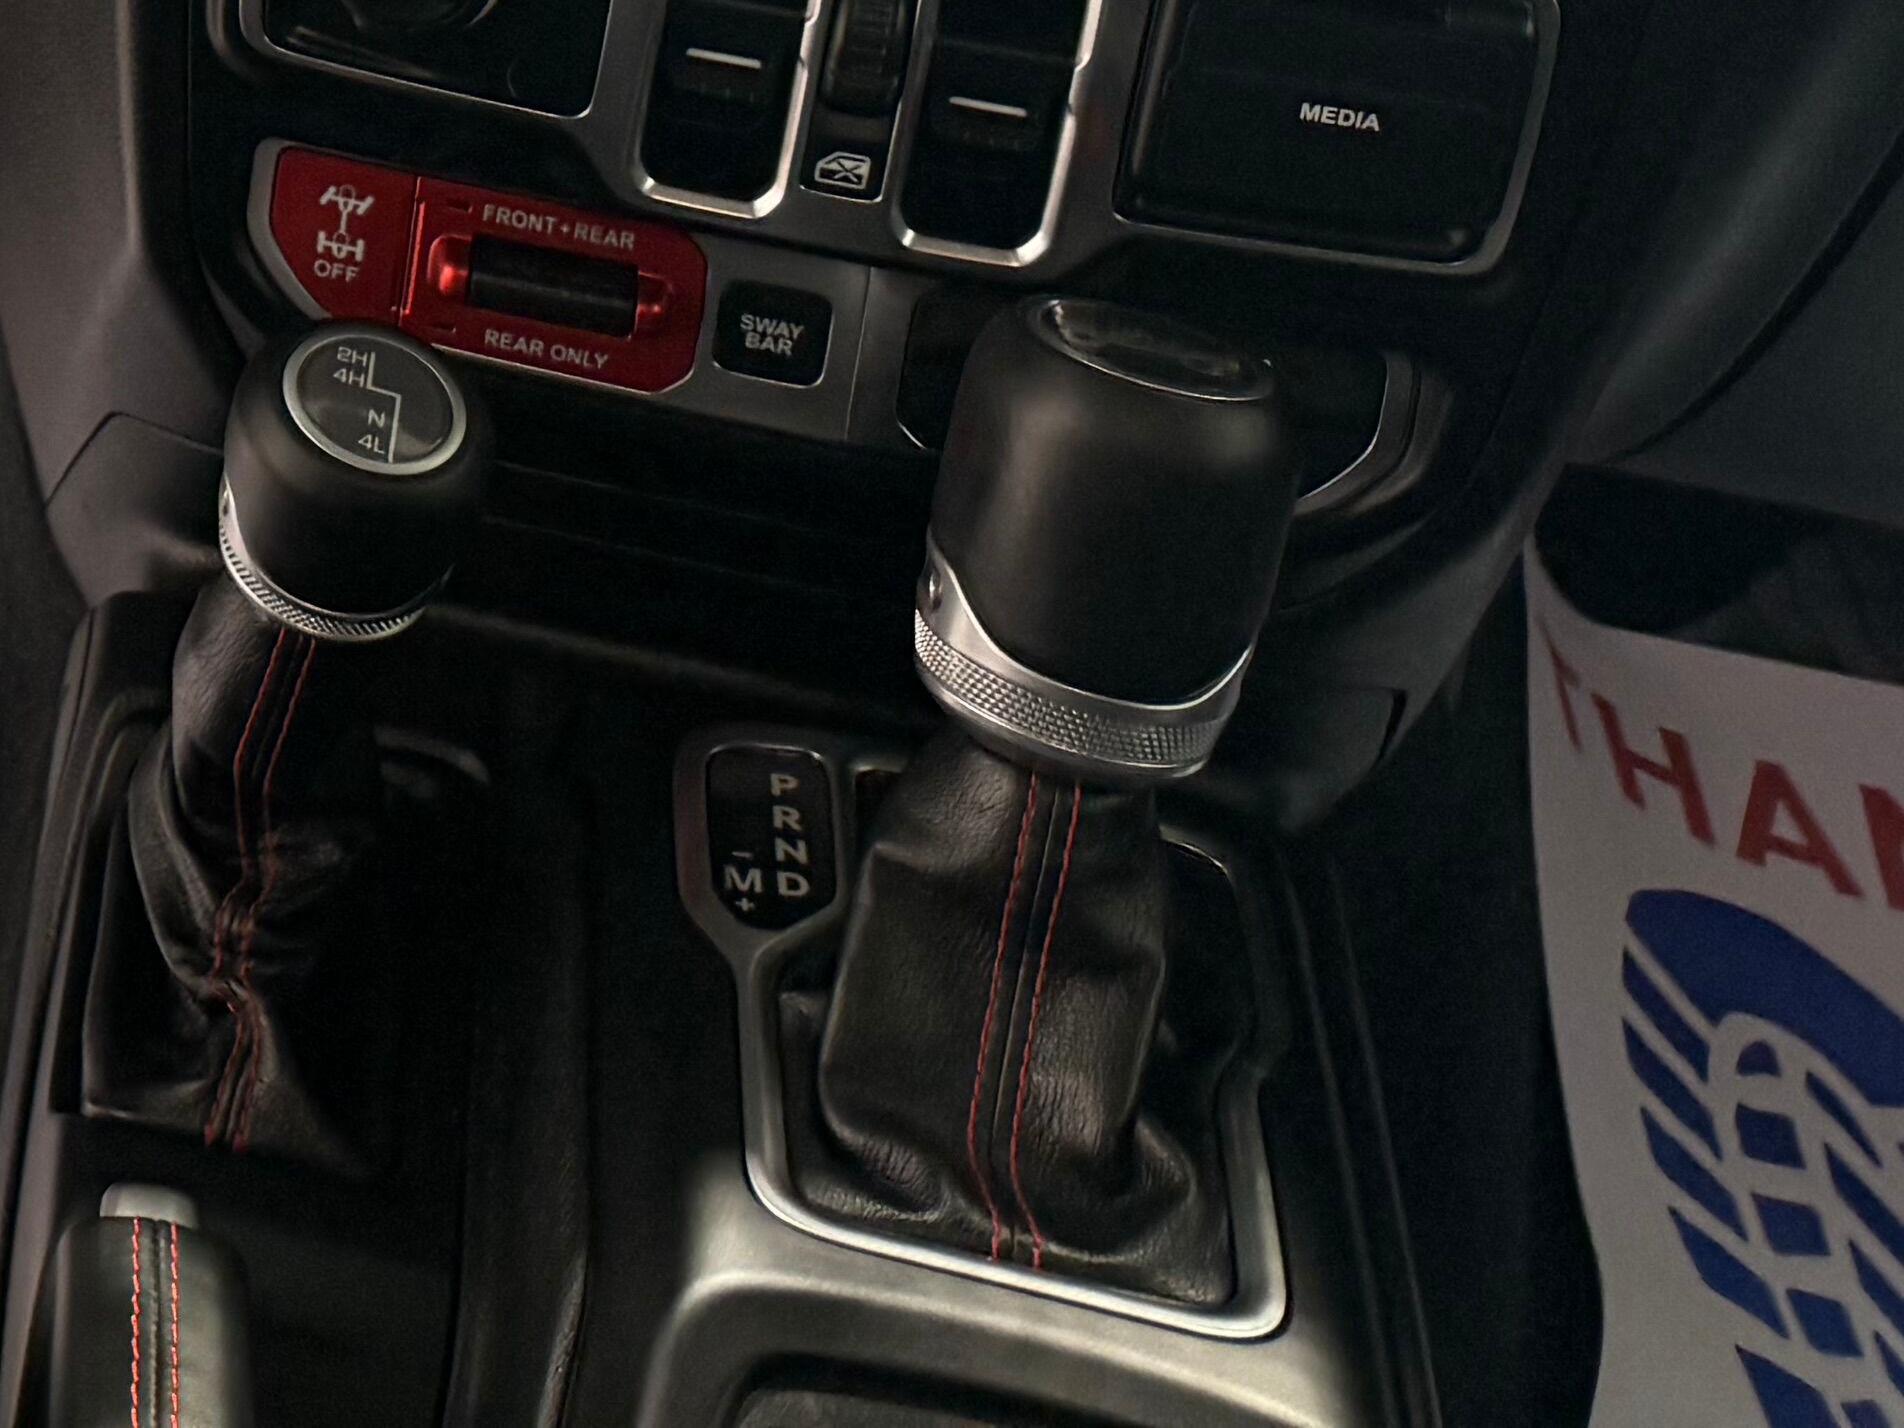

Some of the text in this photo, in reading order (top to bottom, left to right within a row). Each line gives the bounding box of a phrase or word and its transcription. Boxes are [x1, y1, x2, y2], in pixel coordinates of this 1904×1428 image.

[1299, 102, 1380, 132] MEDIA
[481, 203, 557, 237] FRONT
[572, 219, 635, 250] REAR
[312, 259, 360, 283] OFF
[739, 312, 805, 341] SWAY
[336, 346, 369, 367] 2H
[483, 327, 610, 370] REAR ONLY
[744, 331, 794, 358] BAR
[332, 367, 366, 388] 4H
[367, 408, 386, 429] N
[357, 434, 385, 455] 4L
[769, 773, 799, 797] P
[772, 805, 802, 831] R
[773, 836, 809, 865] N
[723, 865, 763, 893] M
[776, 871, 811, 897] D
